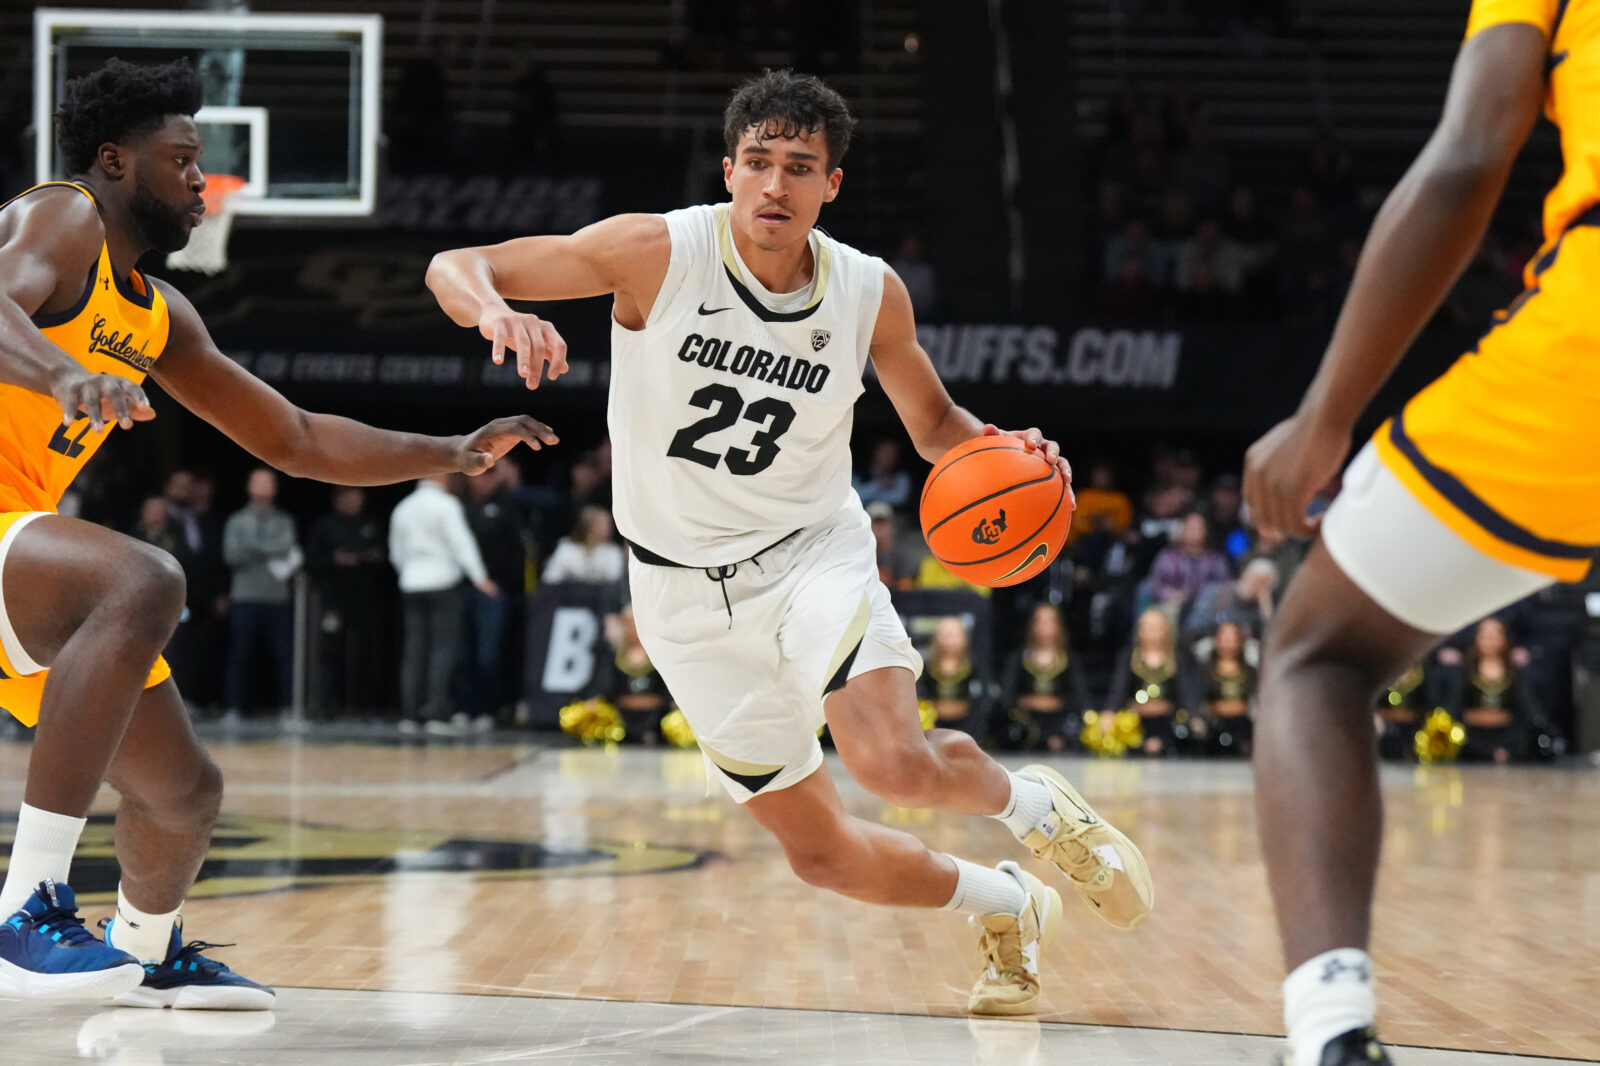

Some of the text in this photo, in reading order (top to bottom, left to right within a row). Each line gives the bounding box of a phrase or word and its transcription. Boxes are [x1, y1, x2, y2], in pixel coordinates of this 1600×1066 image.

[678, 333, 830, 394] COLORADO
[666, 383, 797, 475] 23
[541, 606, 599, 693] B
